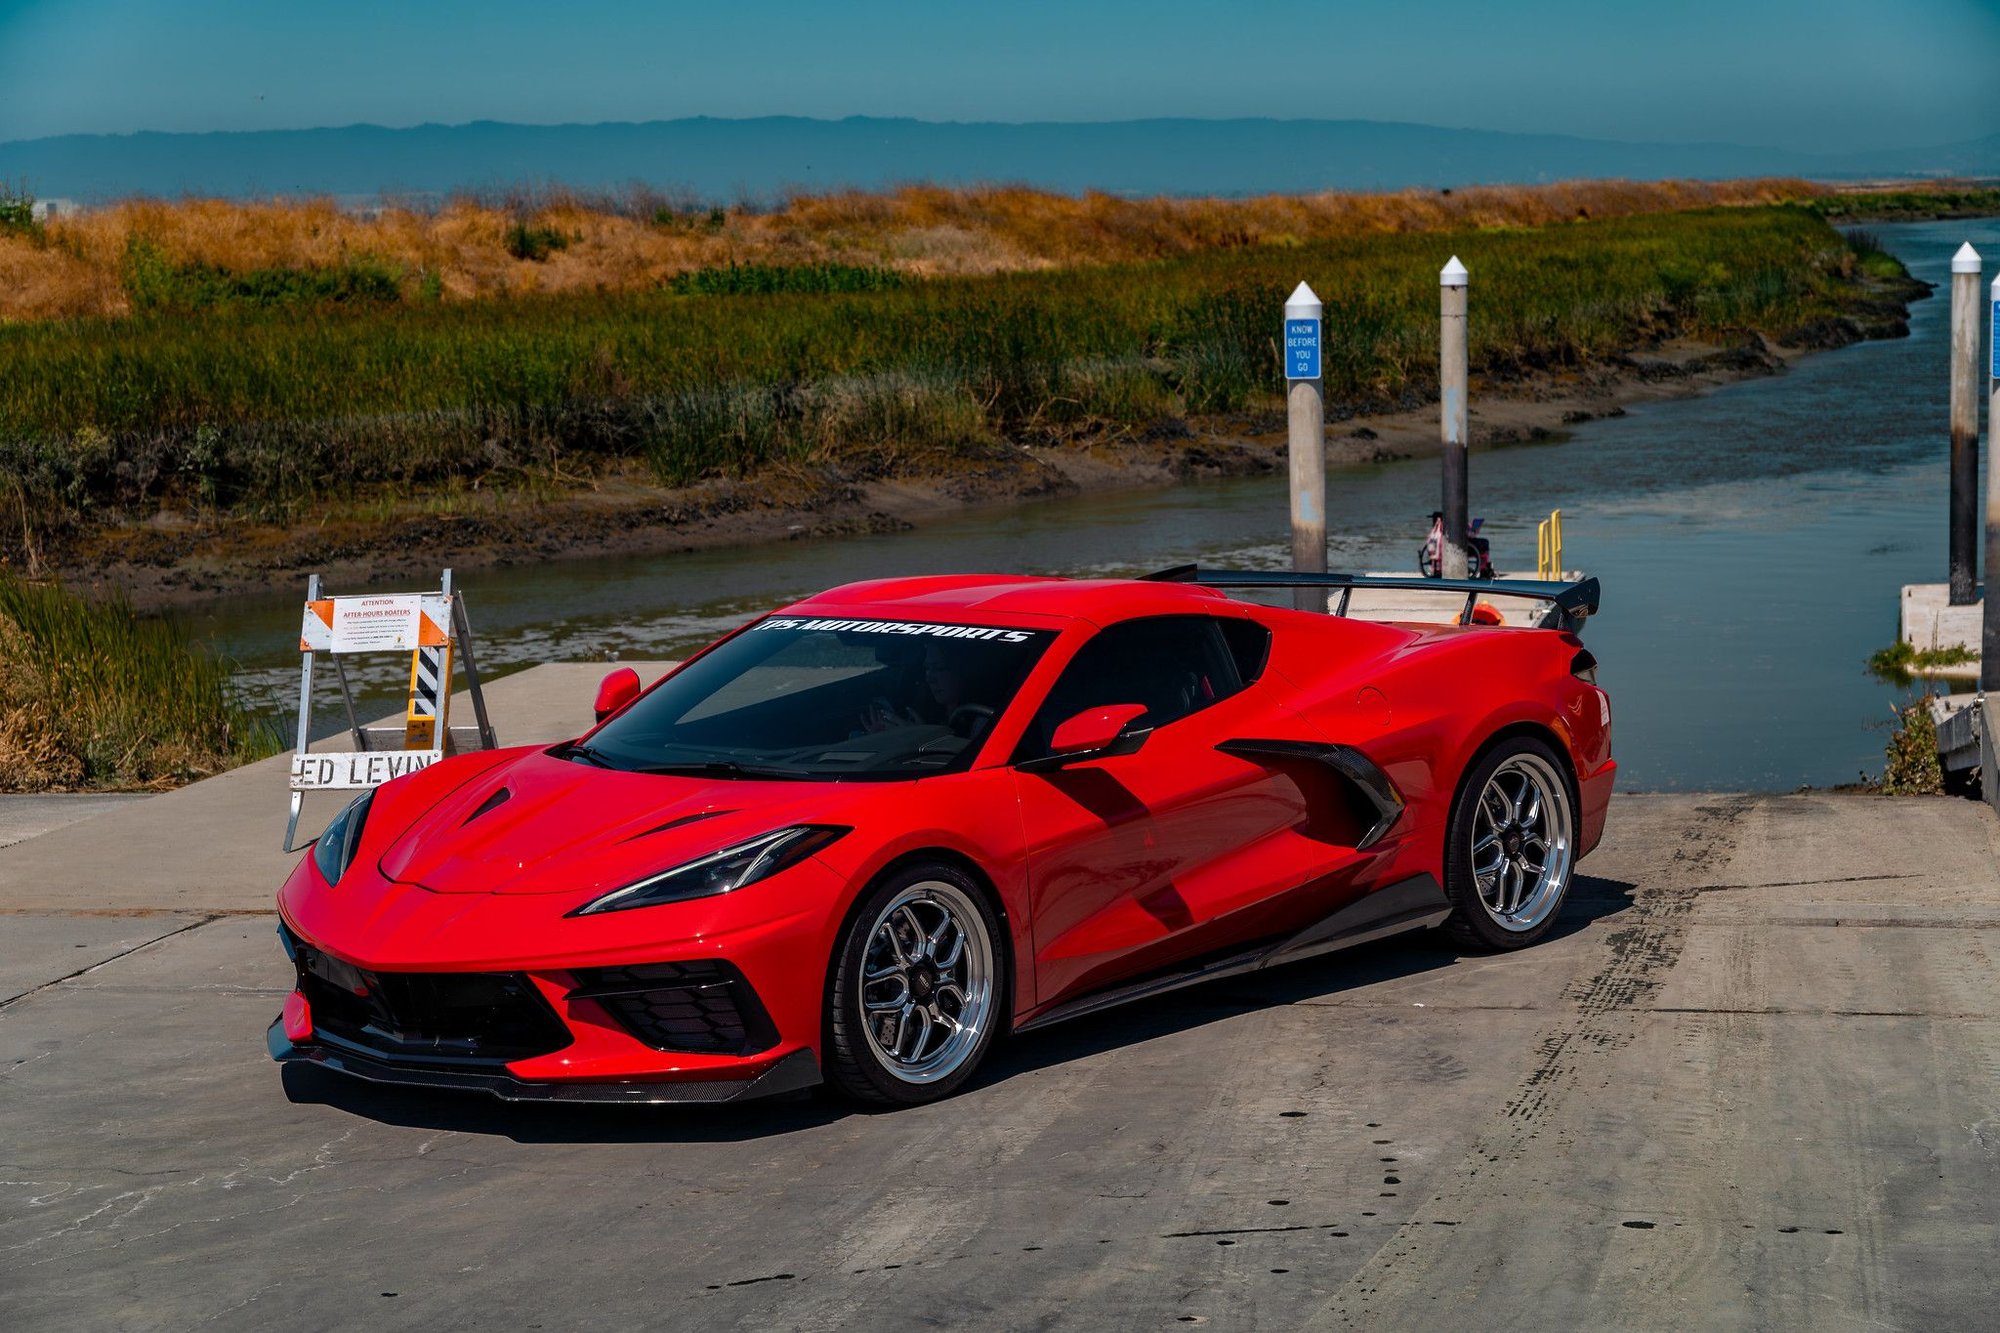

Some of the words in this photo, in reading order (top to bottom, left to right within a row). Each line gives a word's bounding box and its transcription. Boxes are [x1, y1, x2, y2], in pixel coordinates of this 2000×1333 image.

[1291, 326, 1313, 334] KNOW
[1288, 337, 1317, 347] BEFORE
[1295, 350, 1311, 359] YOU
[1297, 362, 1309, 371] GO
[361, 599, 394, 607] ATTENTION
[384, 609, 411, 617] BOATERS
[796, 619, 1036, 643] MOTORSPORTS
[300, 759, 335, 785] ED
